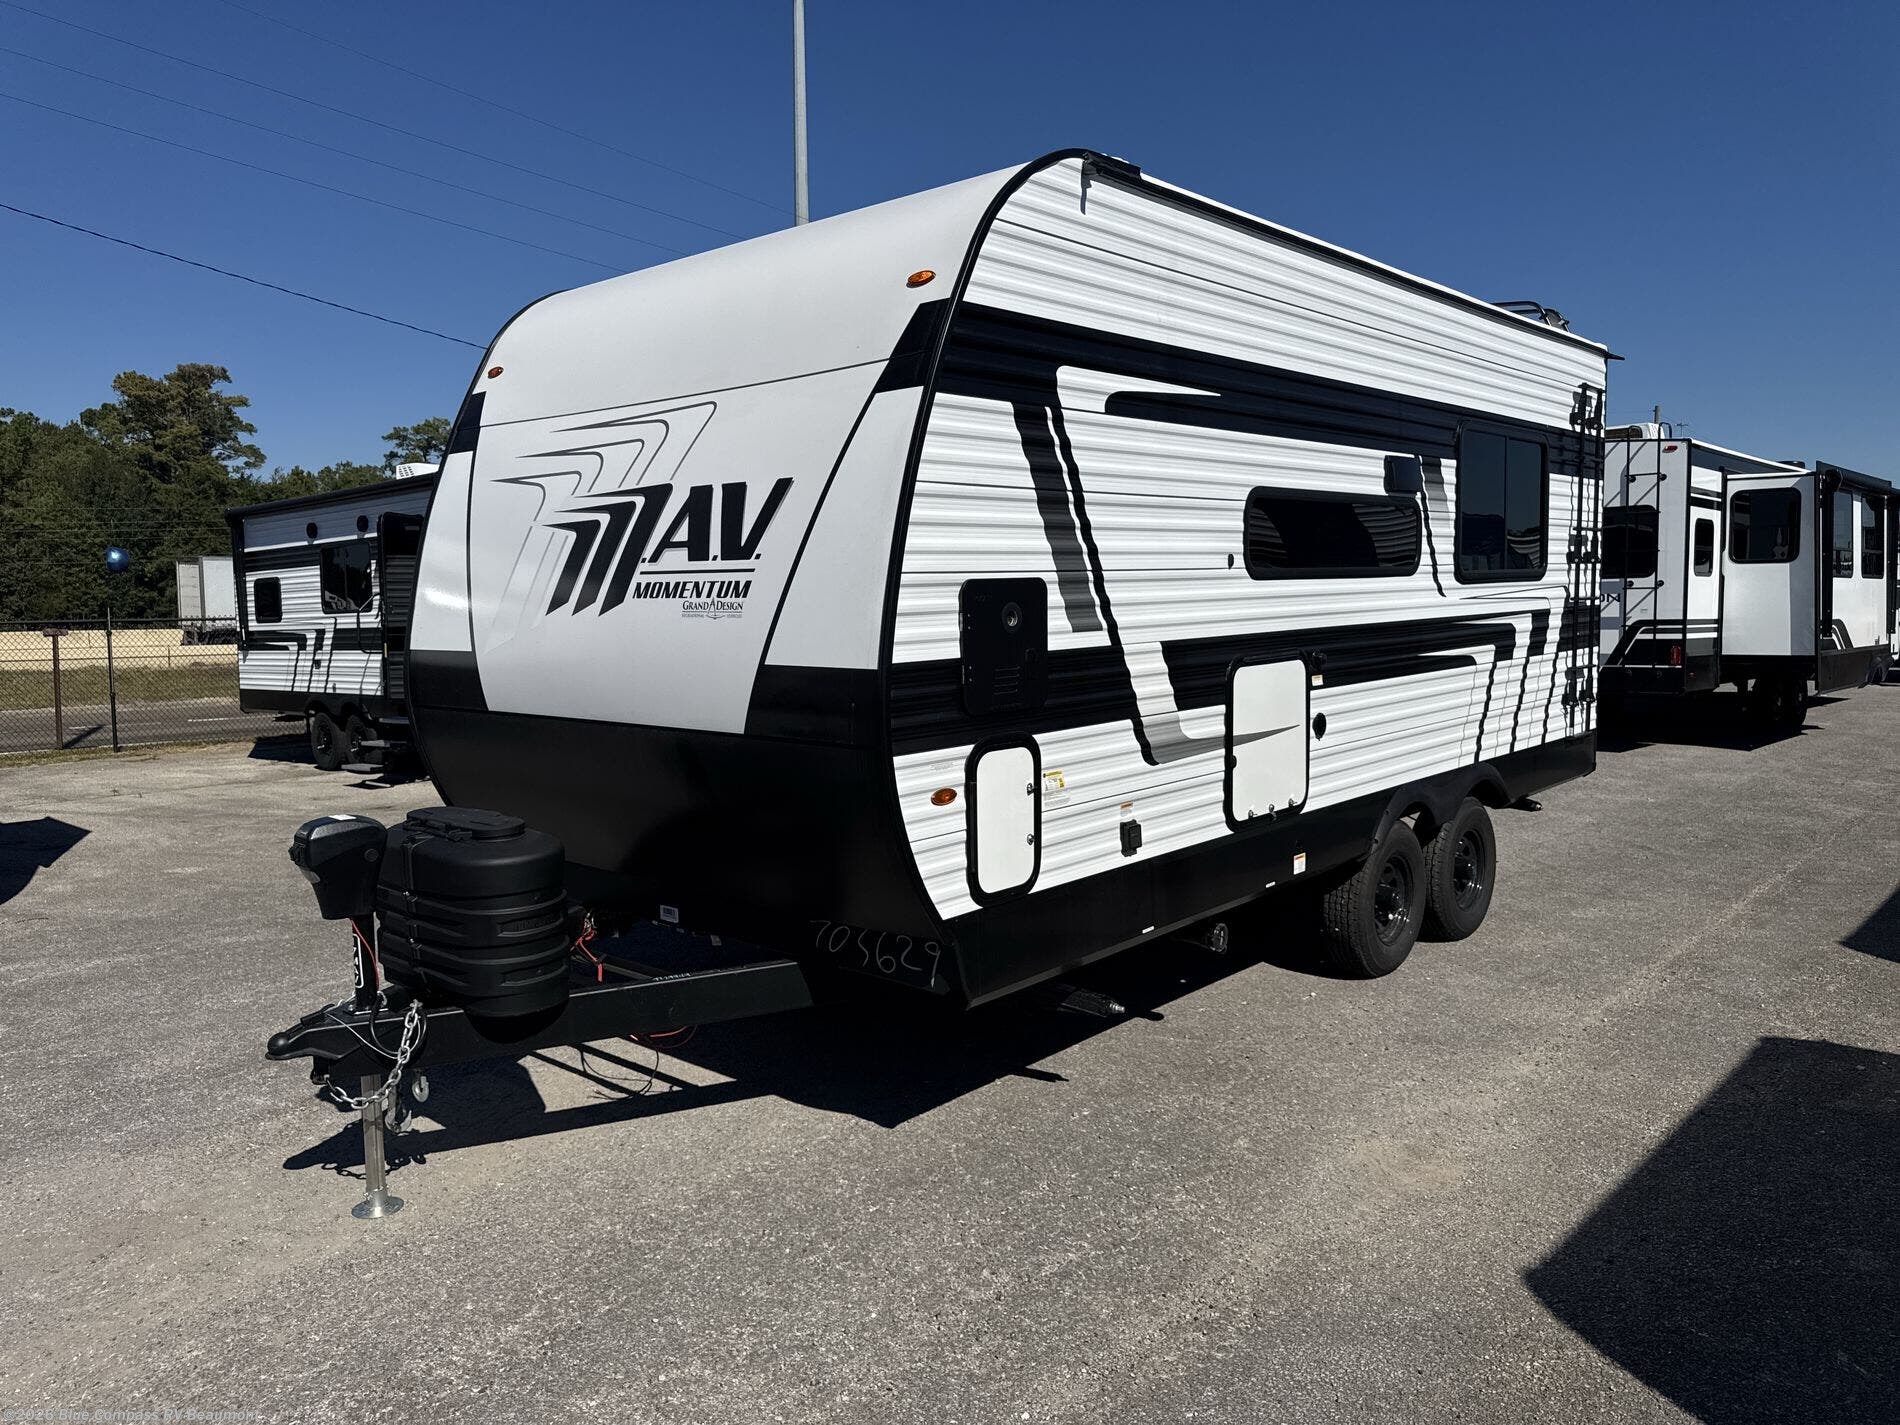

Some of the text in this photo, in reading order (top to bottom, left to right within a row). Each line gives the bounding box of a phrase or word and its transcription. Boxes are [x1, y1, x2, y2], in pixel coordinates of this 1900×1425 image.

[632, 580, 753, 599] MOMENTUM
[716, 600, 744, 611] DESIGN
[809, 920, 941, 988] 705629
